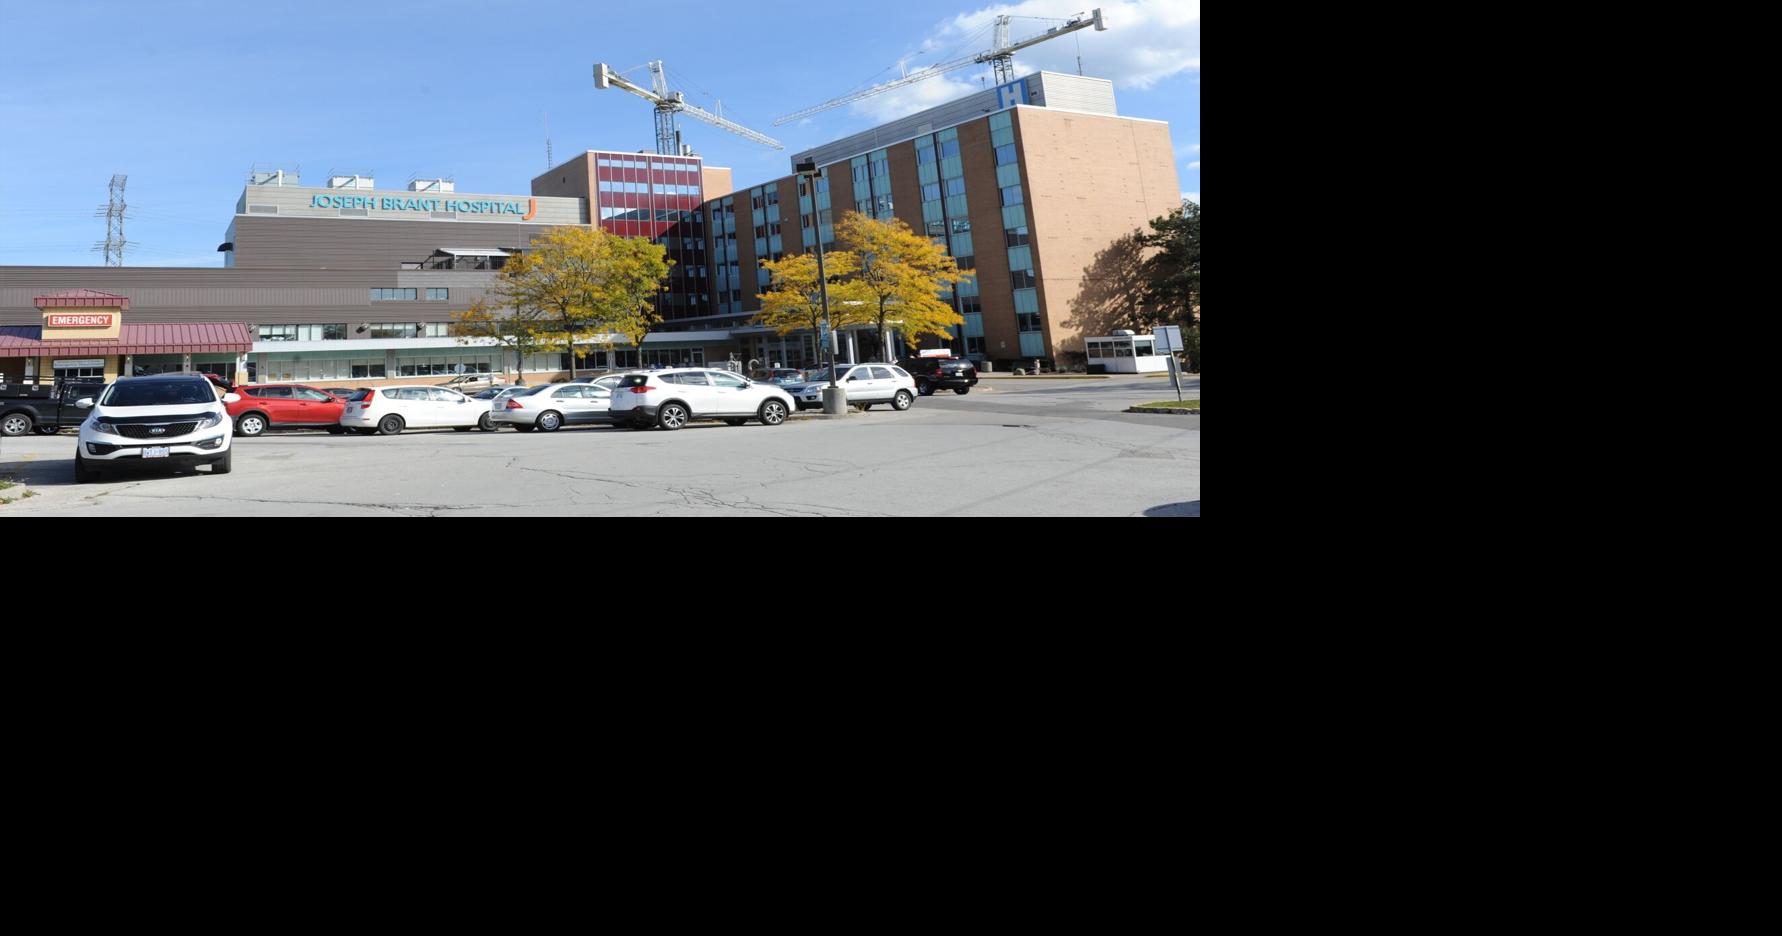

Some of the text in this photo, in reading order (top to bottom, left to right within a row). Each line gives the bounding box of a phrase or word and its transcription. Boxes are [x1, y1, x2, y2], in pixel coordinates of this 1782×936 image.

[309, 194, 525, 215] JOSEPH BRANT HOSPITAL
[52, 315, 109, 325] EMERGENCY
